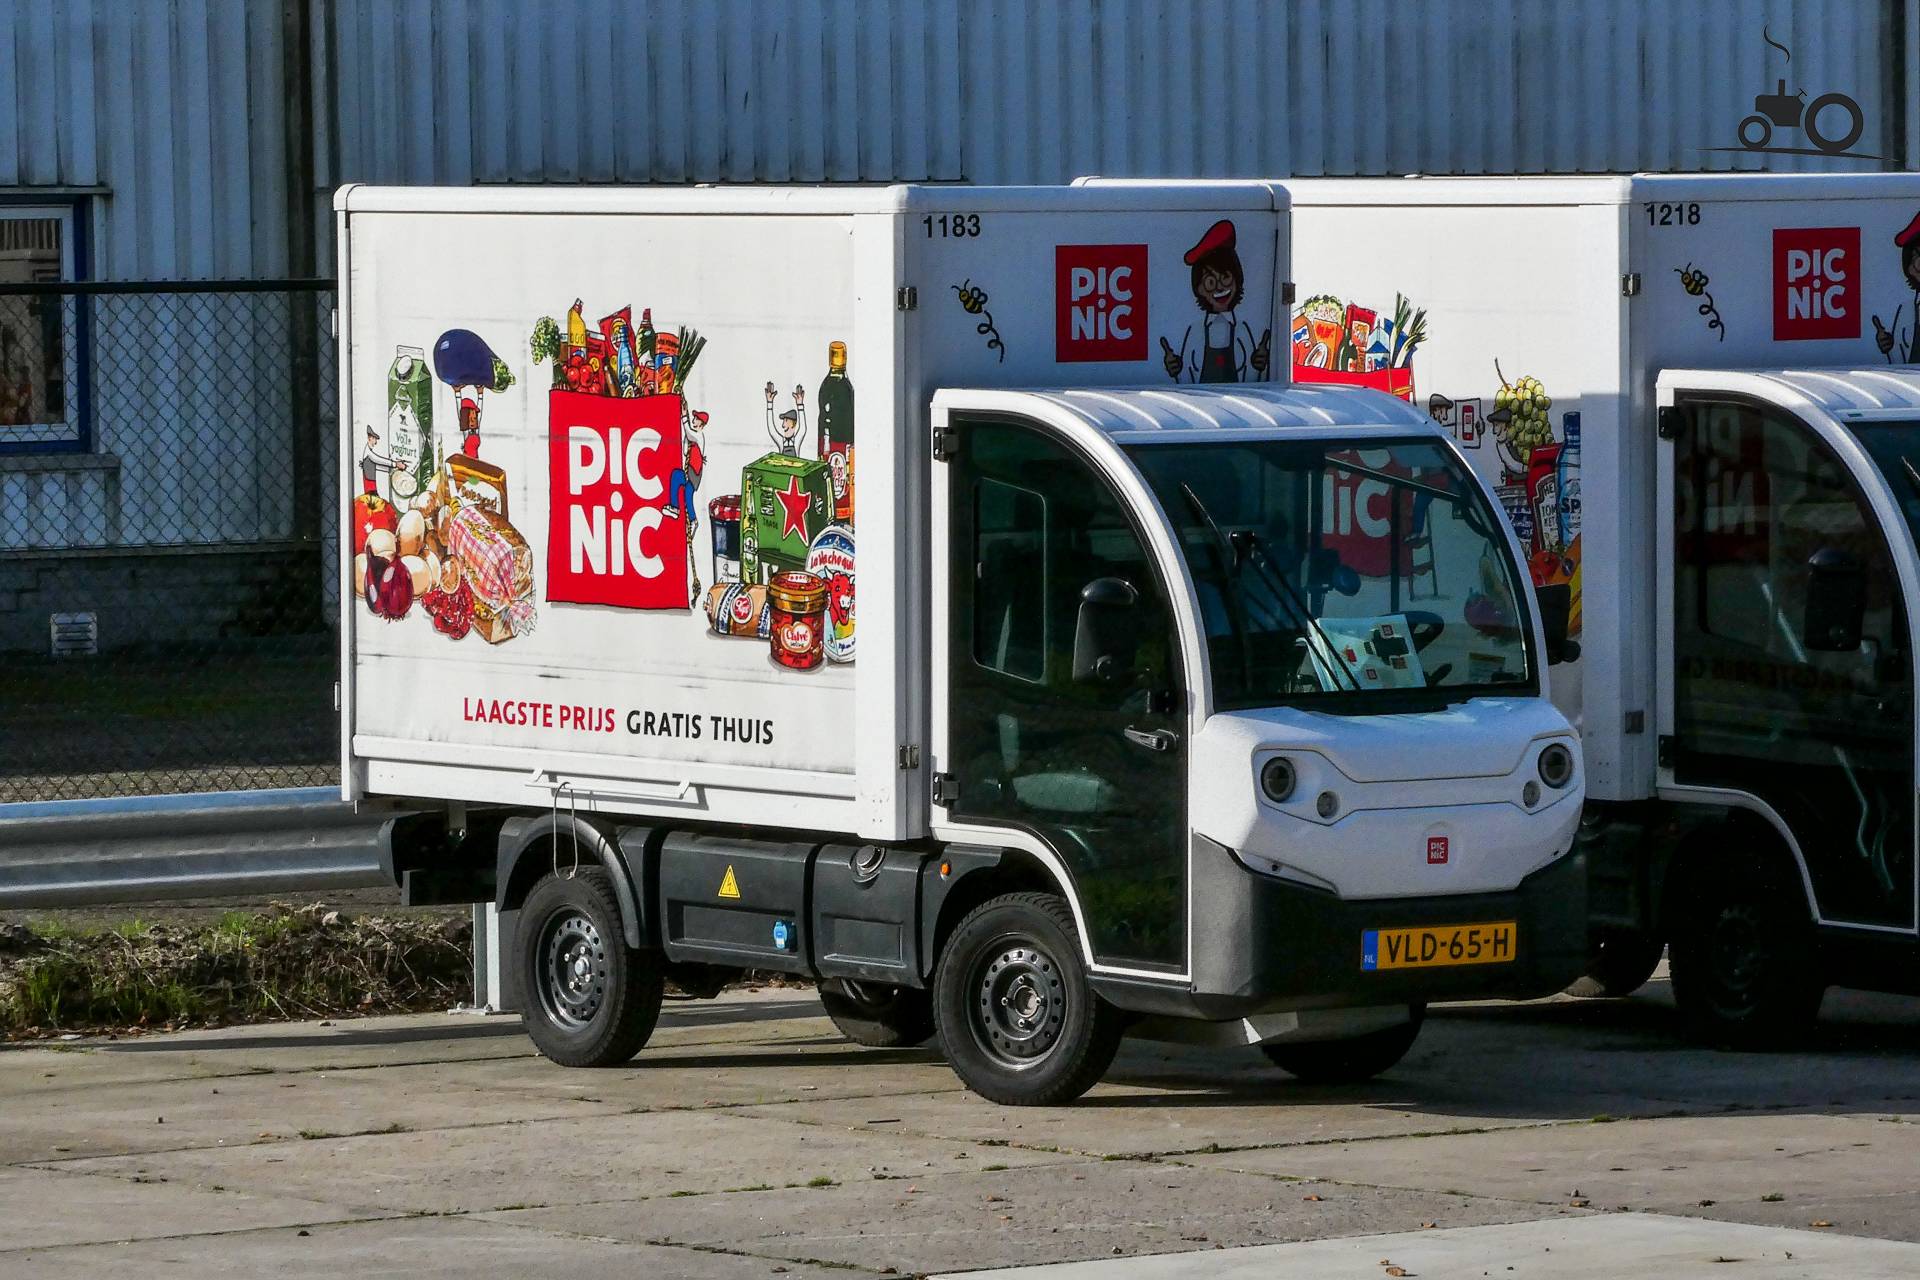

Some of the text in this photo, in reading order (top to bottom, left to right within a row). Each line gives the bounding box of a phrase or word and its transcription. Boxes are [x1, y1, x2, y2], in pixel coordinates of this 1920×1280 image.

[923, 214, 982, 238] 1183
[1646, 203, 1701, 226] 1218
[1787, 248, 1846, 283] PIC
[1071, 266, 1133, 301] PIC
[569, 425, 664, 500] PIC
[464, 697, 774, 745] LAAGSTE PRIJS GRATIS THUIS
[1431, 842, 1445, 850] PIC
[1364, 927, 1509, 964] NL VLD-65-H
